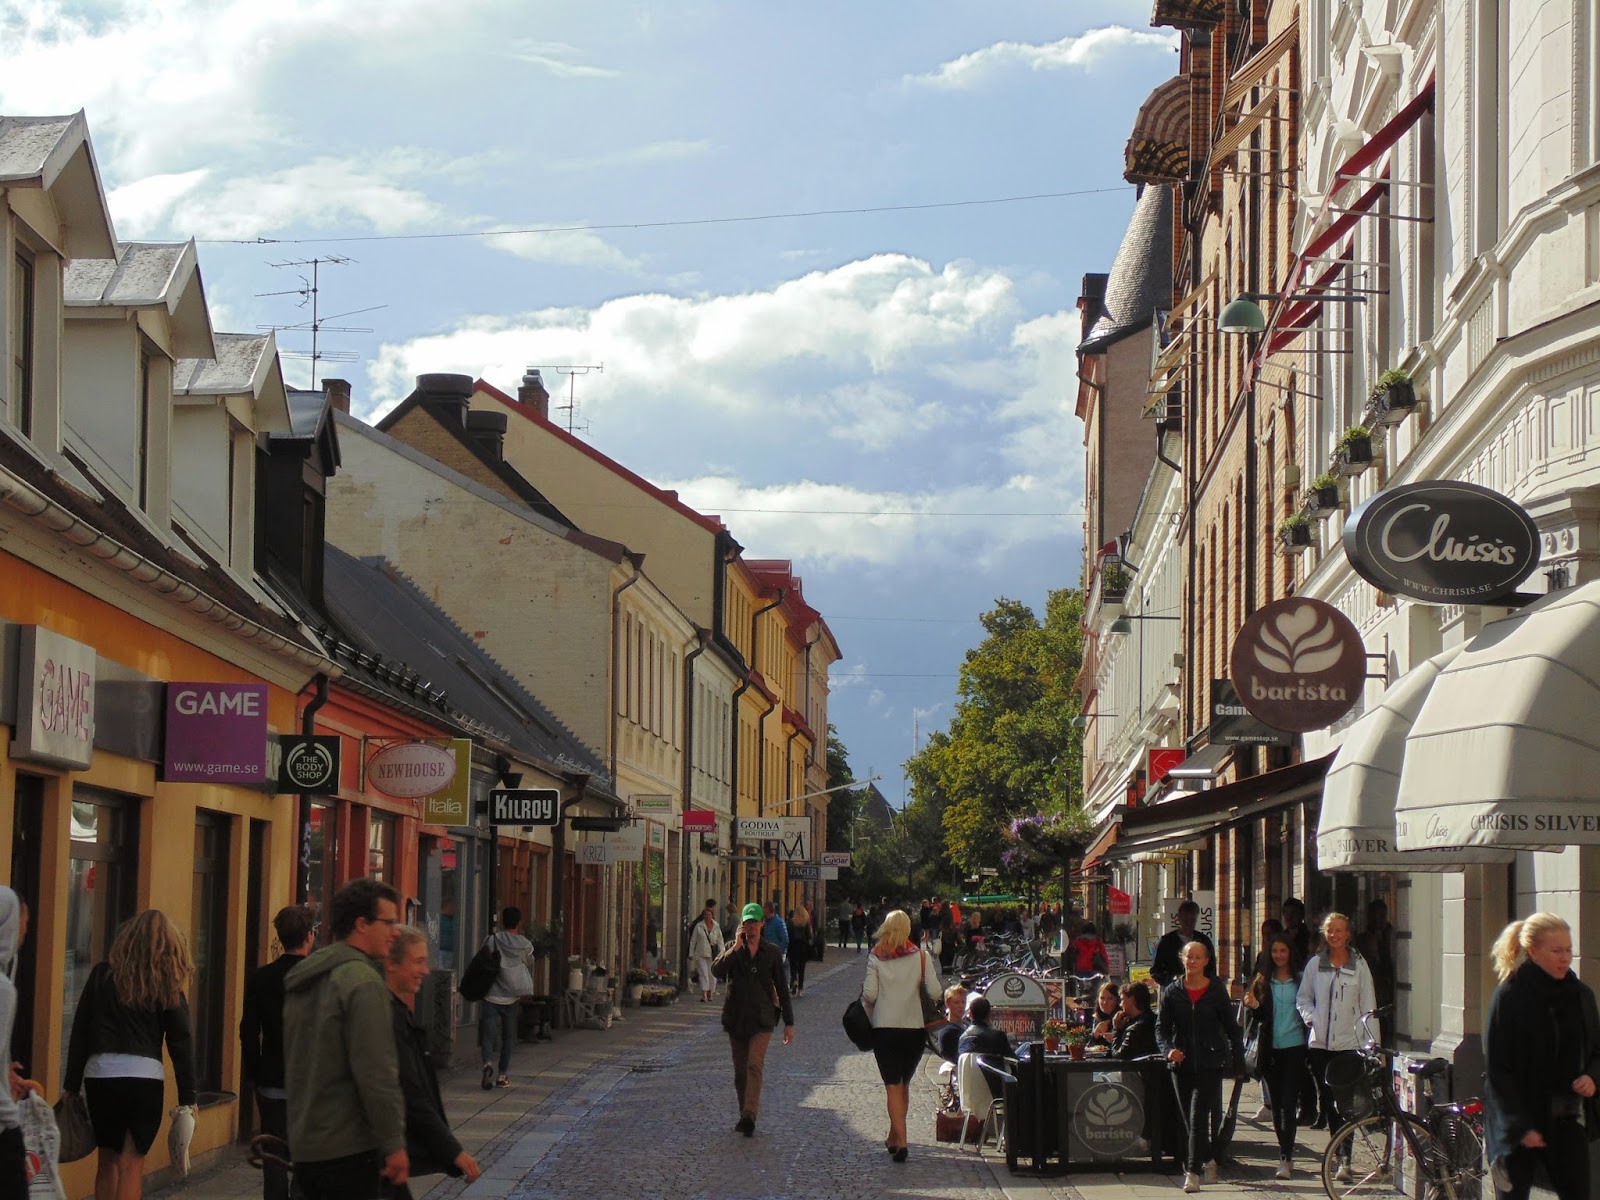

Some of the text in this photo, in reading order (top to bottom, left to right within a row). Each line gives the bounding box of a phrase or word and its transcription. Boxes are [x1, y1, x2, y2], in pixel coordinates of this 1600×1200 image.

[1381, 503, 1517, 566] Chrisis
[1402, 578, 1492, 596] WWW.CHRISIS.SE
[1251, 675, 1347, 702] barista
[40, 658, 90, 742] GAME
[175, 690, 259, 717] GAME
[174, 761, 259, 775] www.game.se
[296, 763, 324, 771] BODY
[297, 771, 322, 779] SHOP
[378, 762, 445, 779] NEWHOUSE
[429, 797, 462, 814] Italia
[740, 821, 780, 830] GODIVA
[1471, 814, 1529, 831] CHRISIS
[582, 845, 606, 862] KRIZI
[1085, 1125, 1134, 1139] barista
